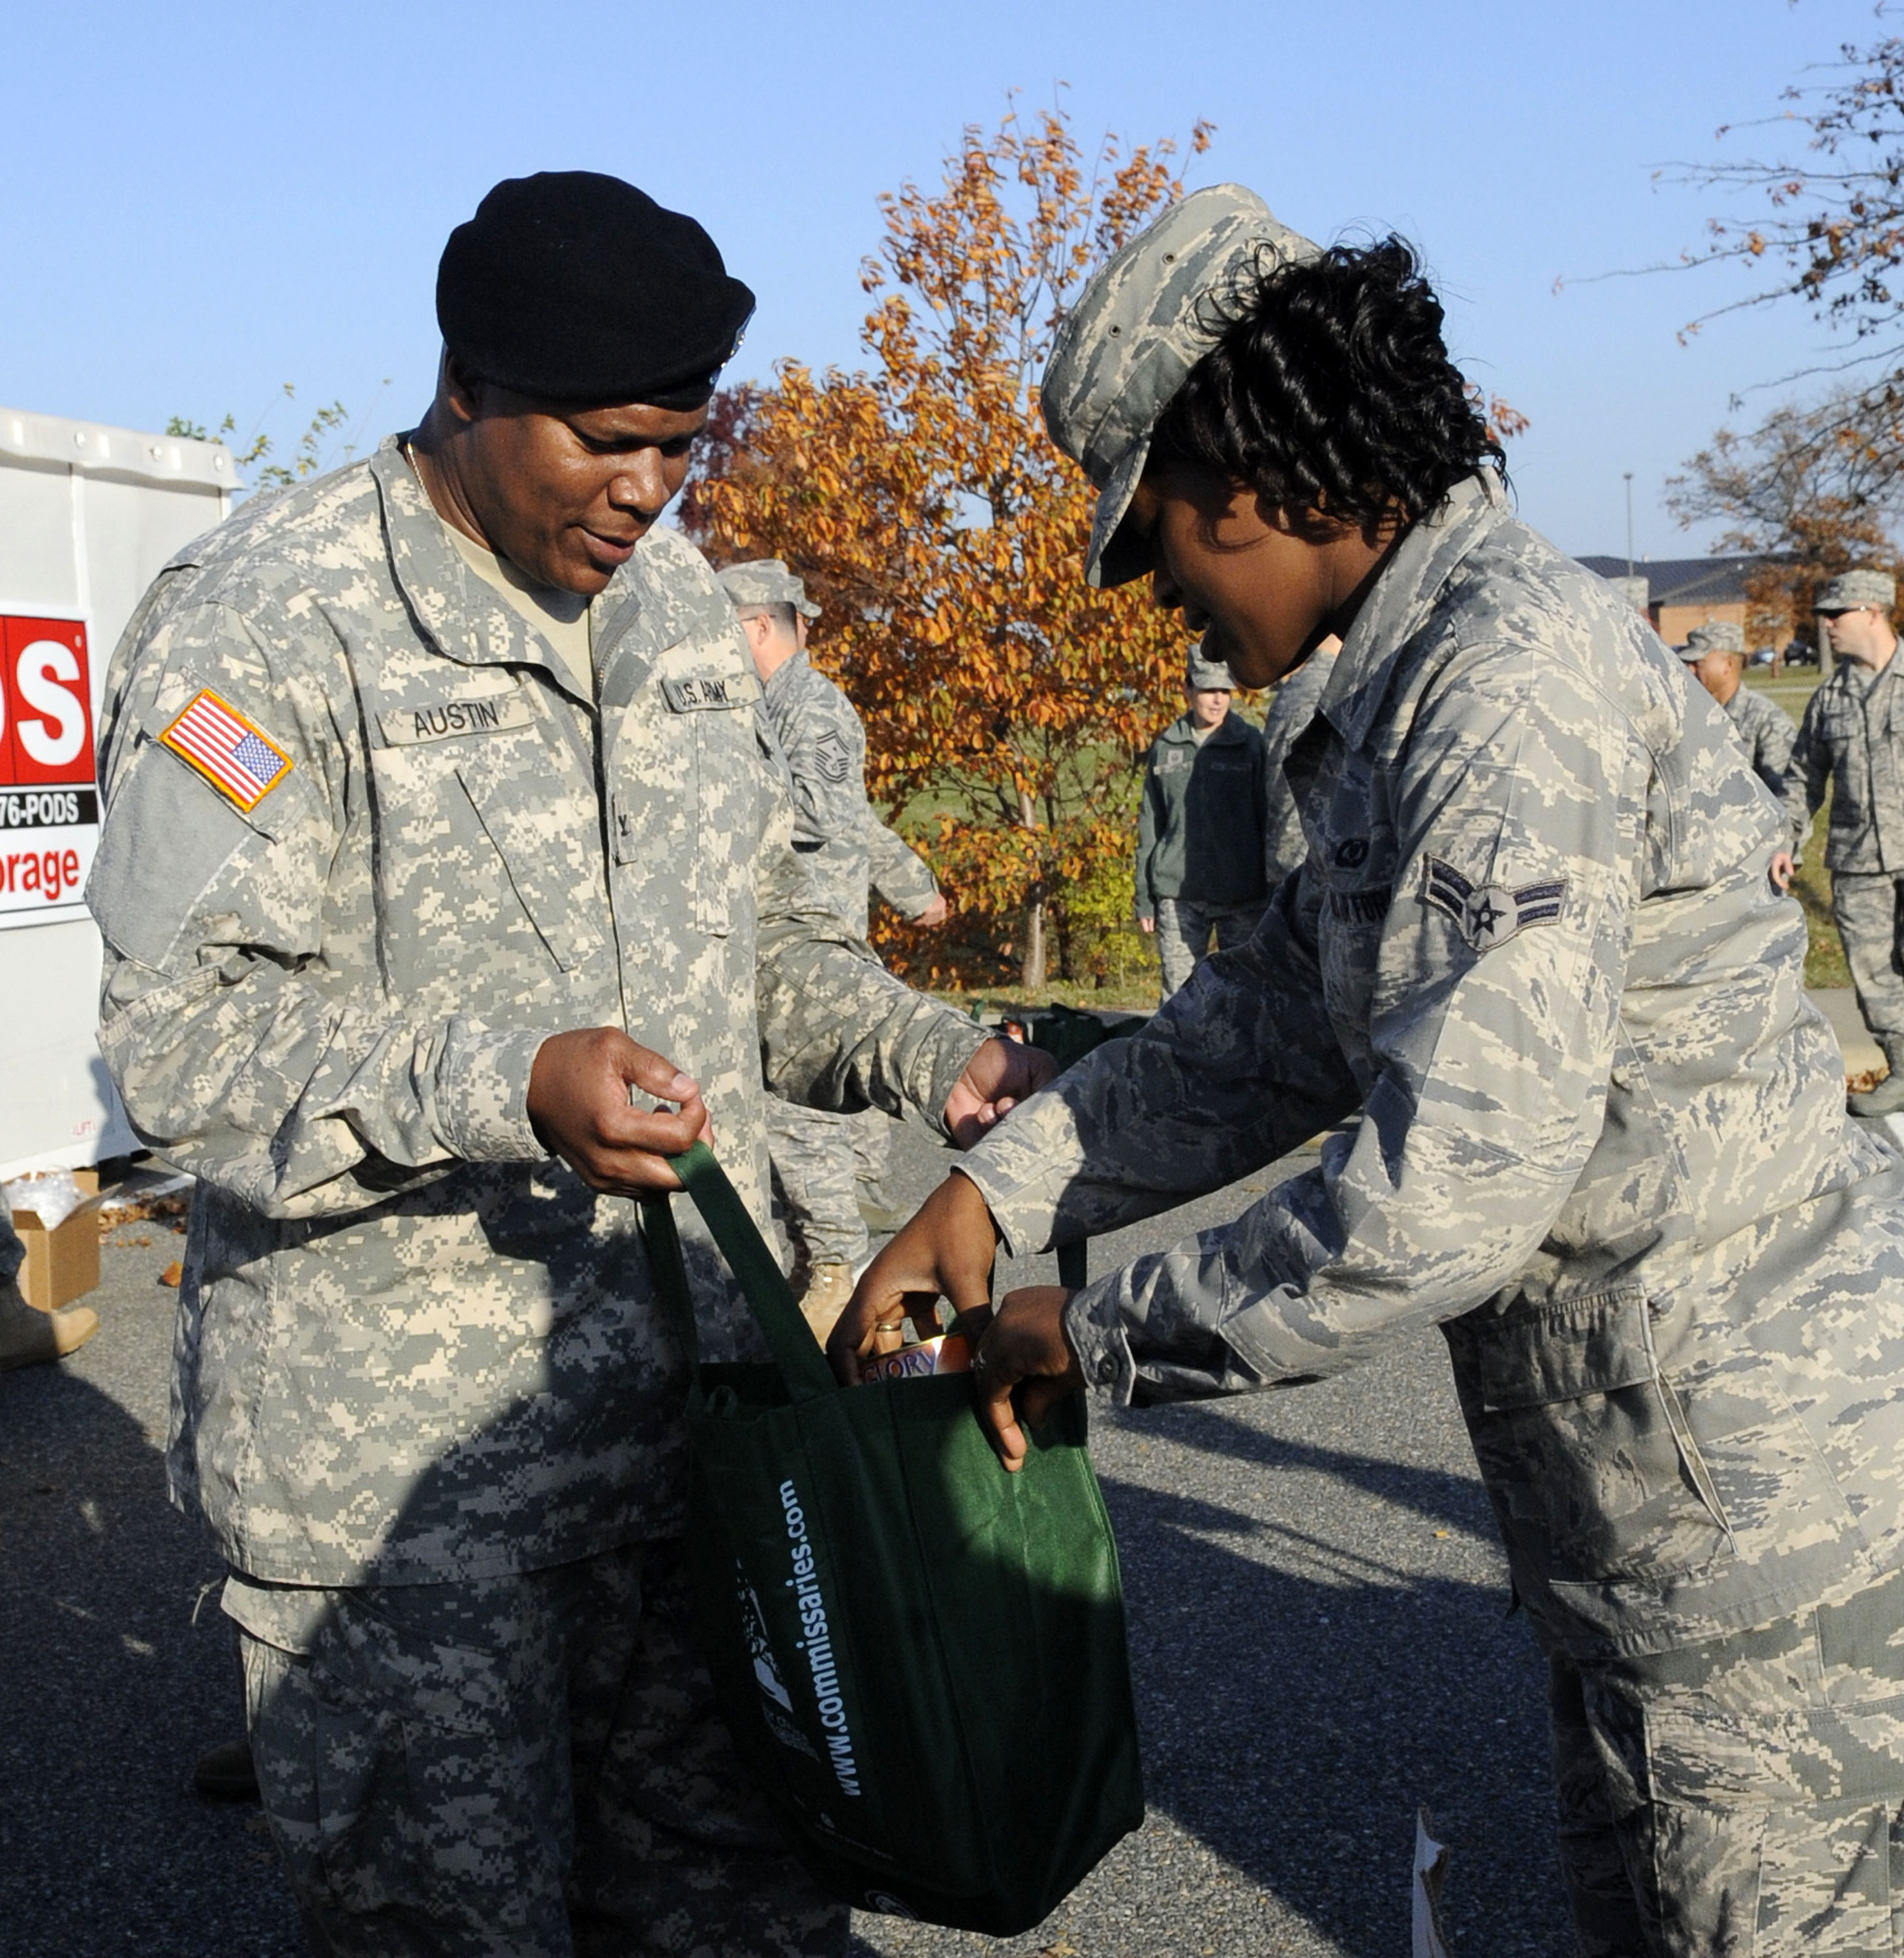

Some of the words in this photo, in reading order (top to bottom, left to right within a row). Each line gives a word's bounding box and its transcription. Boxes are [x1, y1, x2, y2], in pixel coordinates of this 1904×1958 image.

[0, 639, 85, 766] S
[414, 702, 500, 738] AUSTIN
[673, 682, 701, 706] U.S.
[779, 1479, 861, 1797] www.commissaries.com
